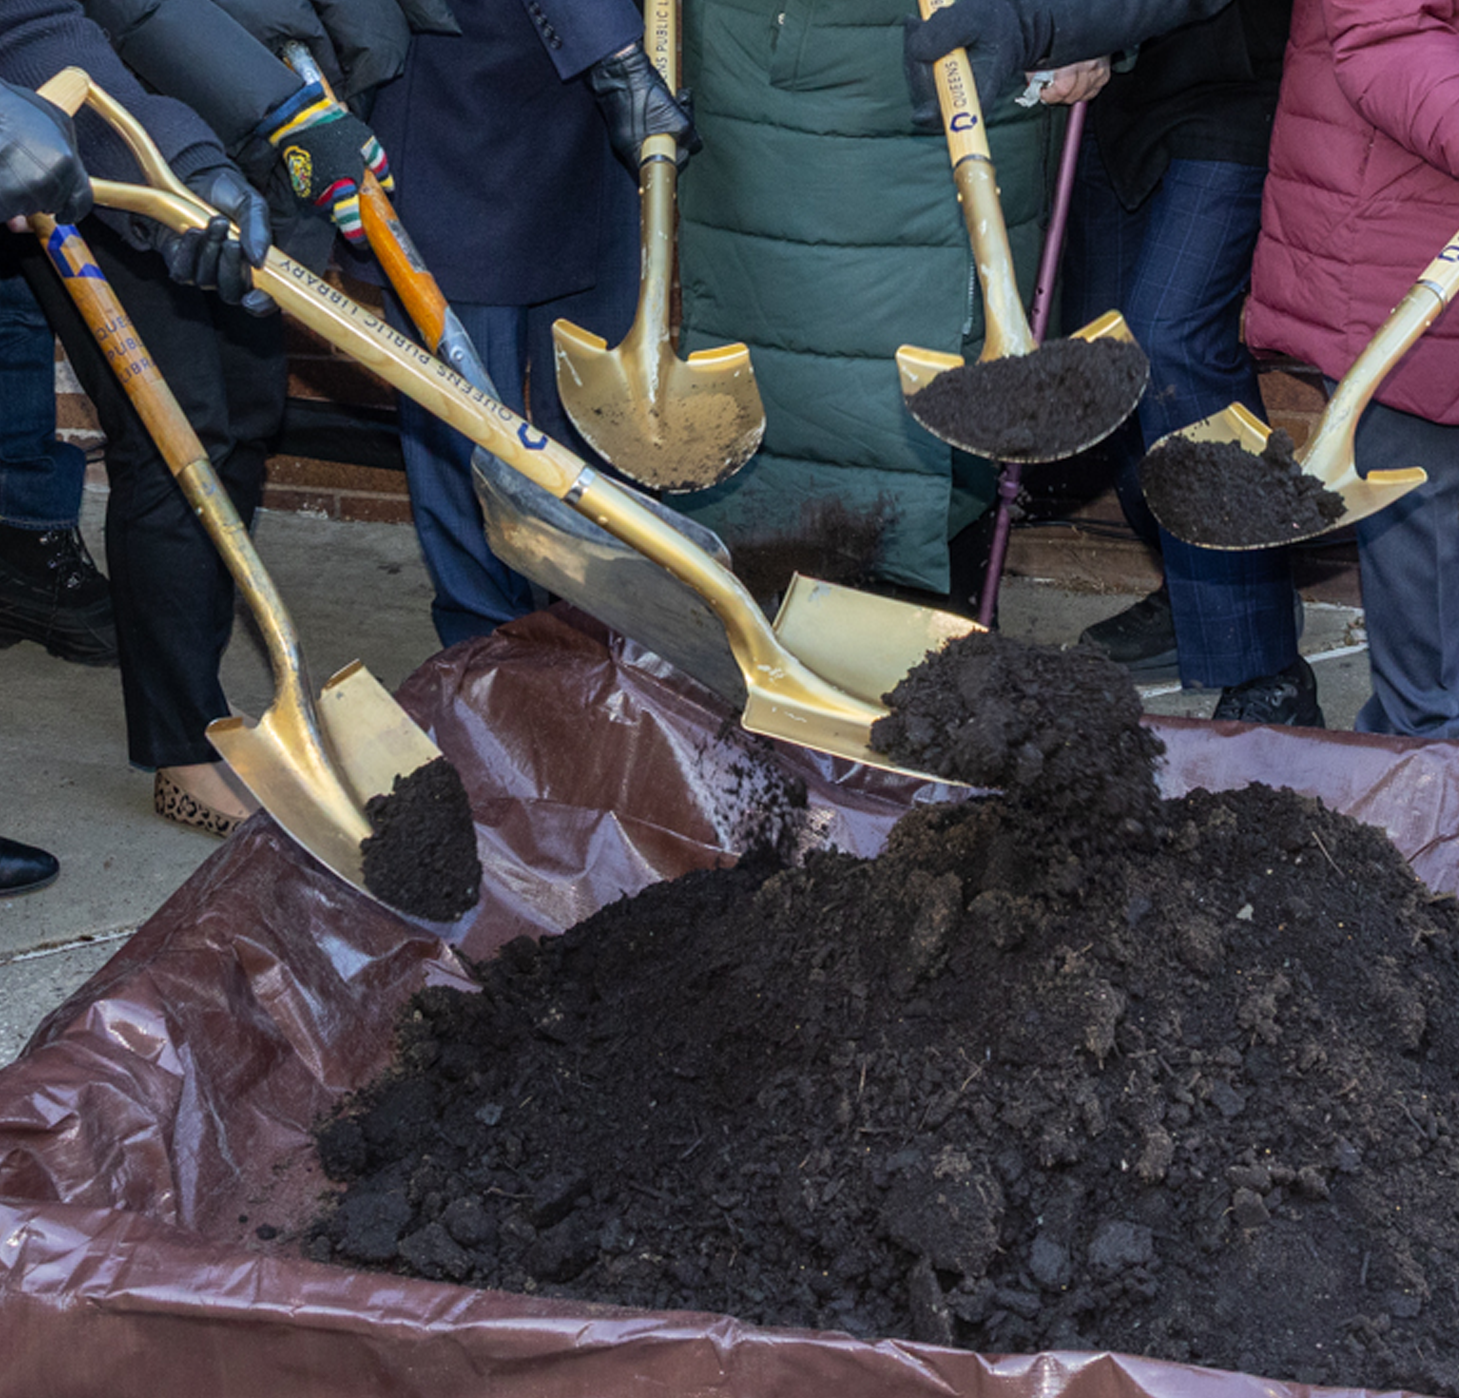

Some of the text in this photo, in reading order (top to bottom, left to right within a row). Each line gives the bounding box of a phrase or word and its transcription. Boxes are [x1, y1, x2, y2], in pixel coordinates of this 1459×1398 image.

[655, 10, 669, 52] PUBLIC
[944, 60, 967, 109] QUEENS
[279, 258, 360, 315] LIBRARY
[363, 312, 431, 367] PUBLIC
